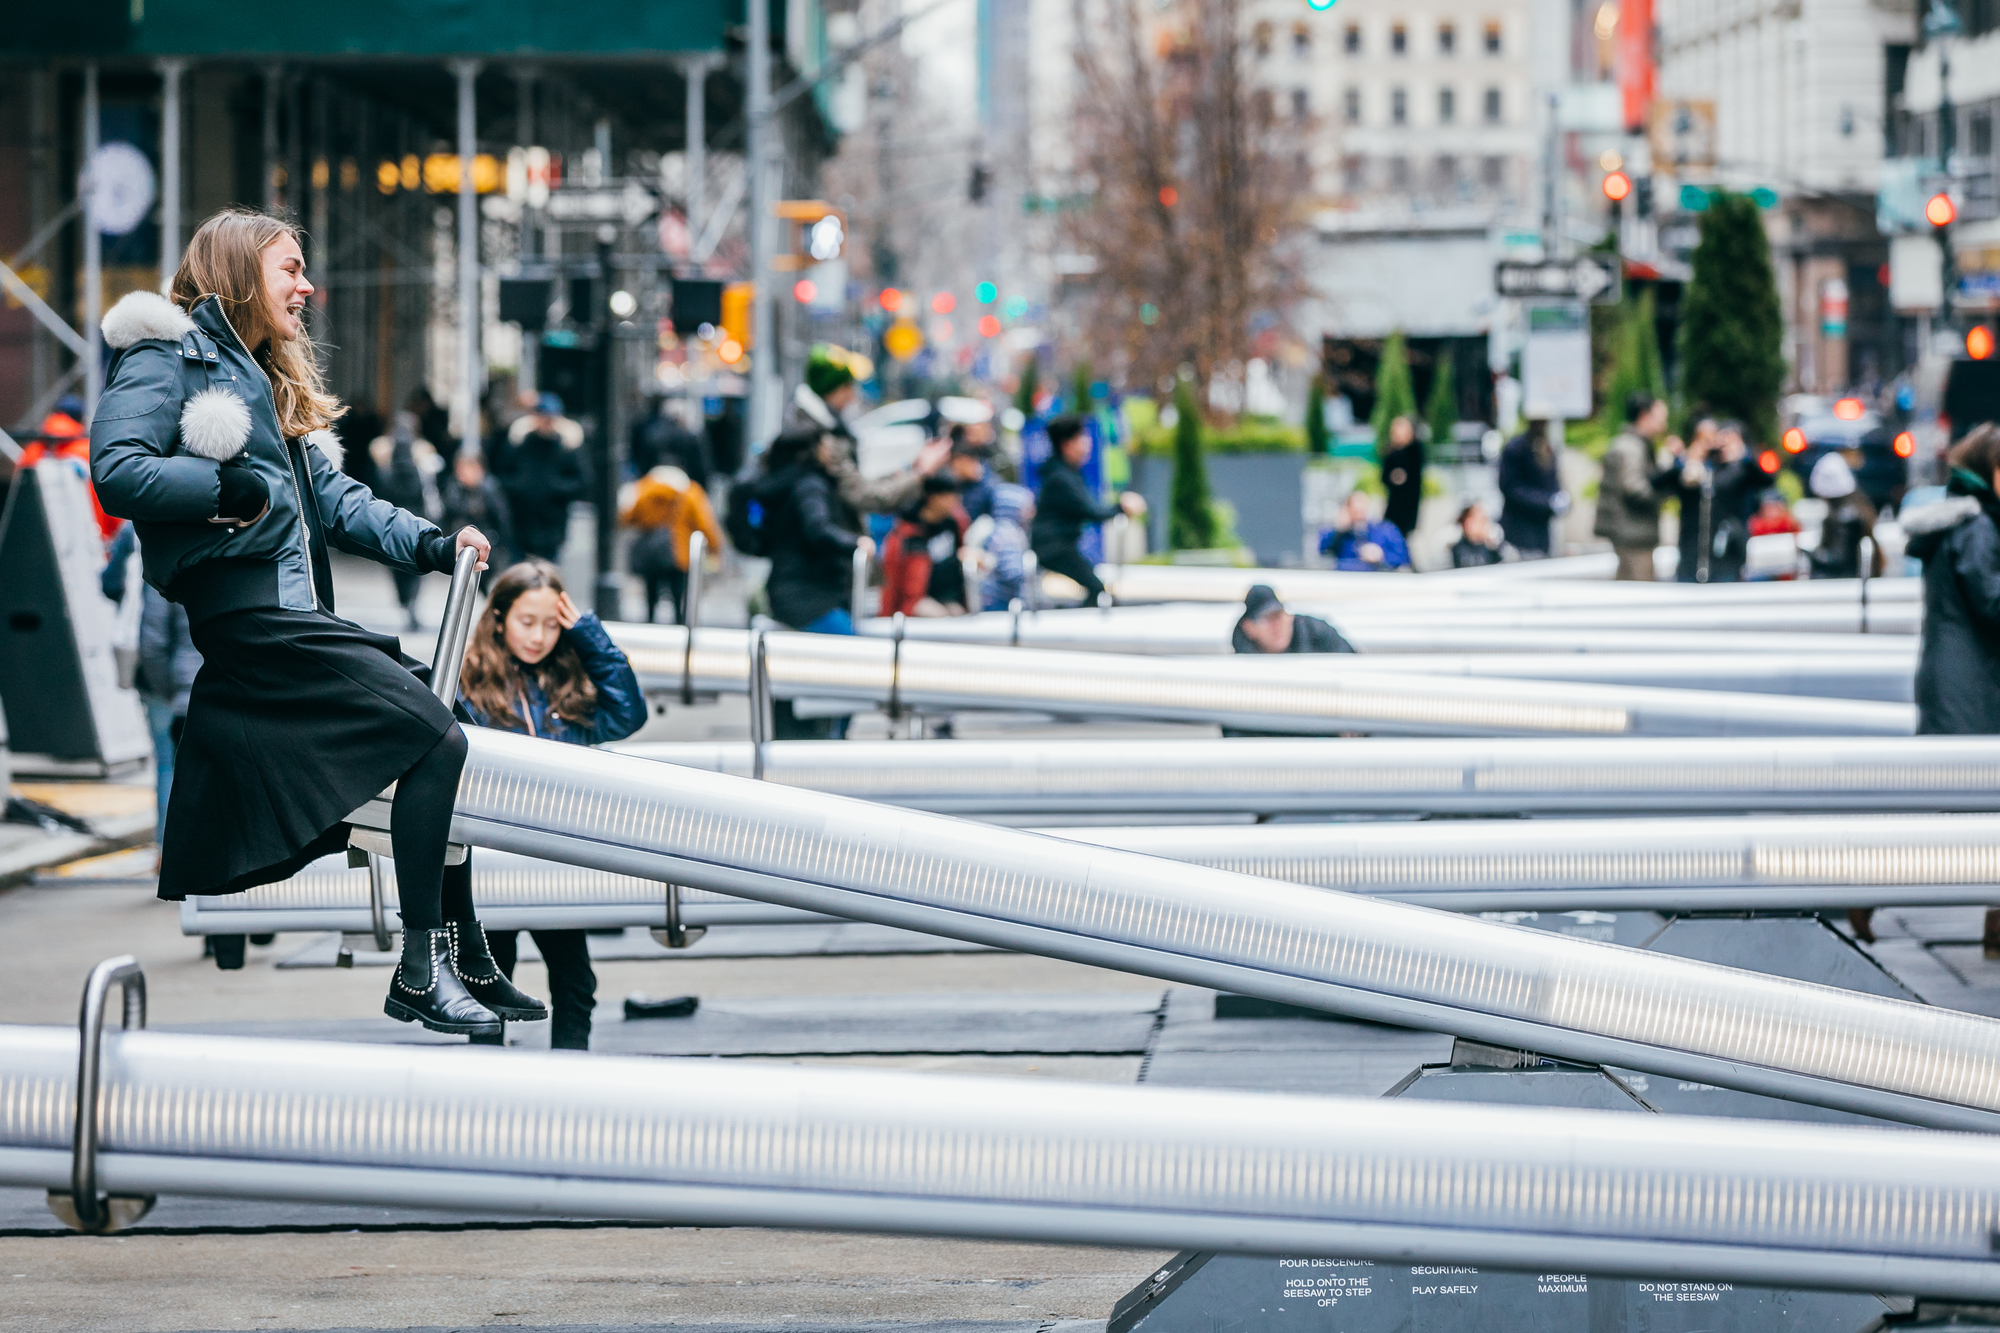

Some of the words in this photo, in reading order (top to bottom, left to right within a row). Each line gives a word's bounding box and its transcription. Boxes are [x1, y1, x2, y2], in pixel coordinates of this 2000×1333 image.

[1279, 1259, 1309, 1268] POUR
[1311, 1258, 1375, 1267] DESCENDRE
[1286, 1279, 1315, 1288] HOLD
[1316, 1278, 1346, 1287] ONTO
[1348, 1277, 1369, 1286] THE
[1537, 1274, 1544, 1283] 4
[1546, 1274, 1588, 1283] PEOPLE
[1412, 1286, 1438, 1295] PLAY
[1439, 1285, 1478, 1294] SAFELY
[1538, 1284, 1588, 1293] MAXIMUM
[1639, 1283, 1655, 1292] DO
[1657, 1283, 1679, 1292] NOT
[1681, 1283, 1715, 1292] STAND
[1717, 1283, 1733, 1291] ON
[1283, 1289, 1327, 1298] SEESAW
[1328, 1288, 1343, 1297] TO
[1345, 1288, 1372, 1297] STEP
[1653, 1293, 1674, 1302] THE
[1676, 1292, 1720, 1302] SEESAW
[1317, 1298, 1338, 1308] OFF
